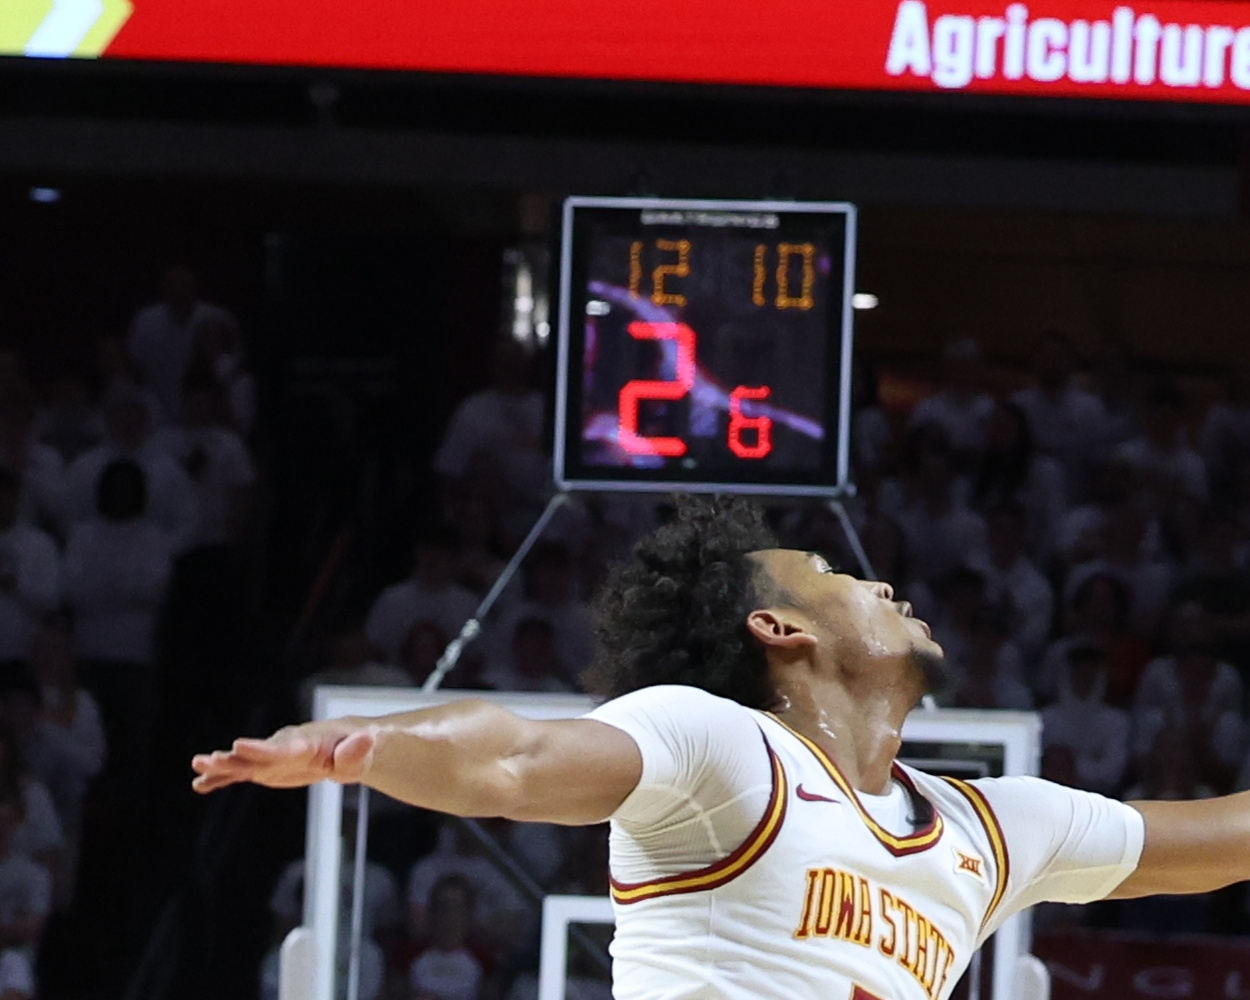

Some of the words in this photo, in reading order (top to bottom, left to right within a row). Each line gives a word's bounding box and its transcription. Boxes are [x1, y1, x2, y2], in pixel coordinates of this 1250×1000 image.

[629, 238, 691, 306] 12
[752, 241, 815, 310] 10
[618, 321, 696, 457] 2
[728, 385, 772, 458] 6
[794, 867, 872, 949] IOWA
